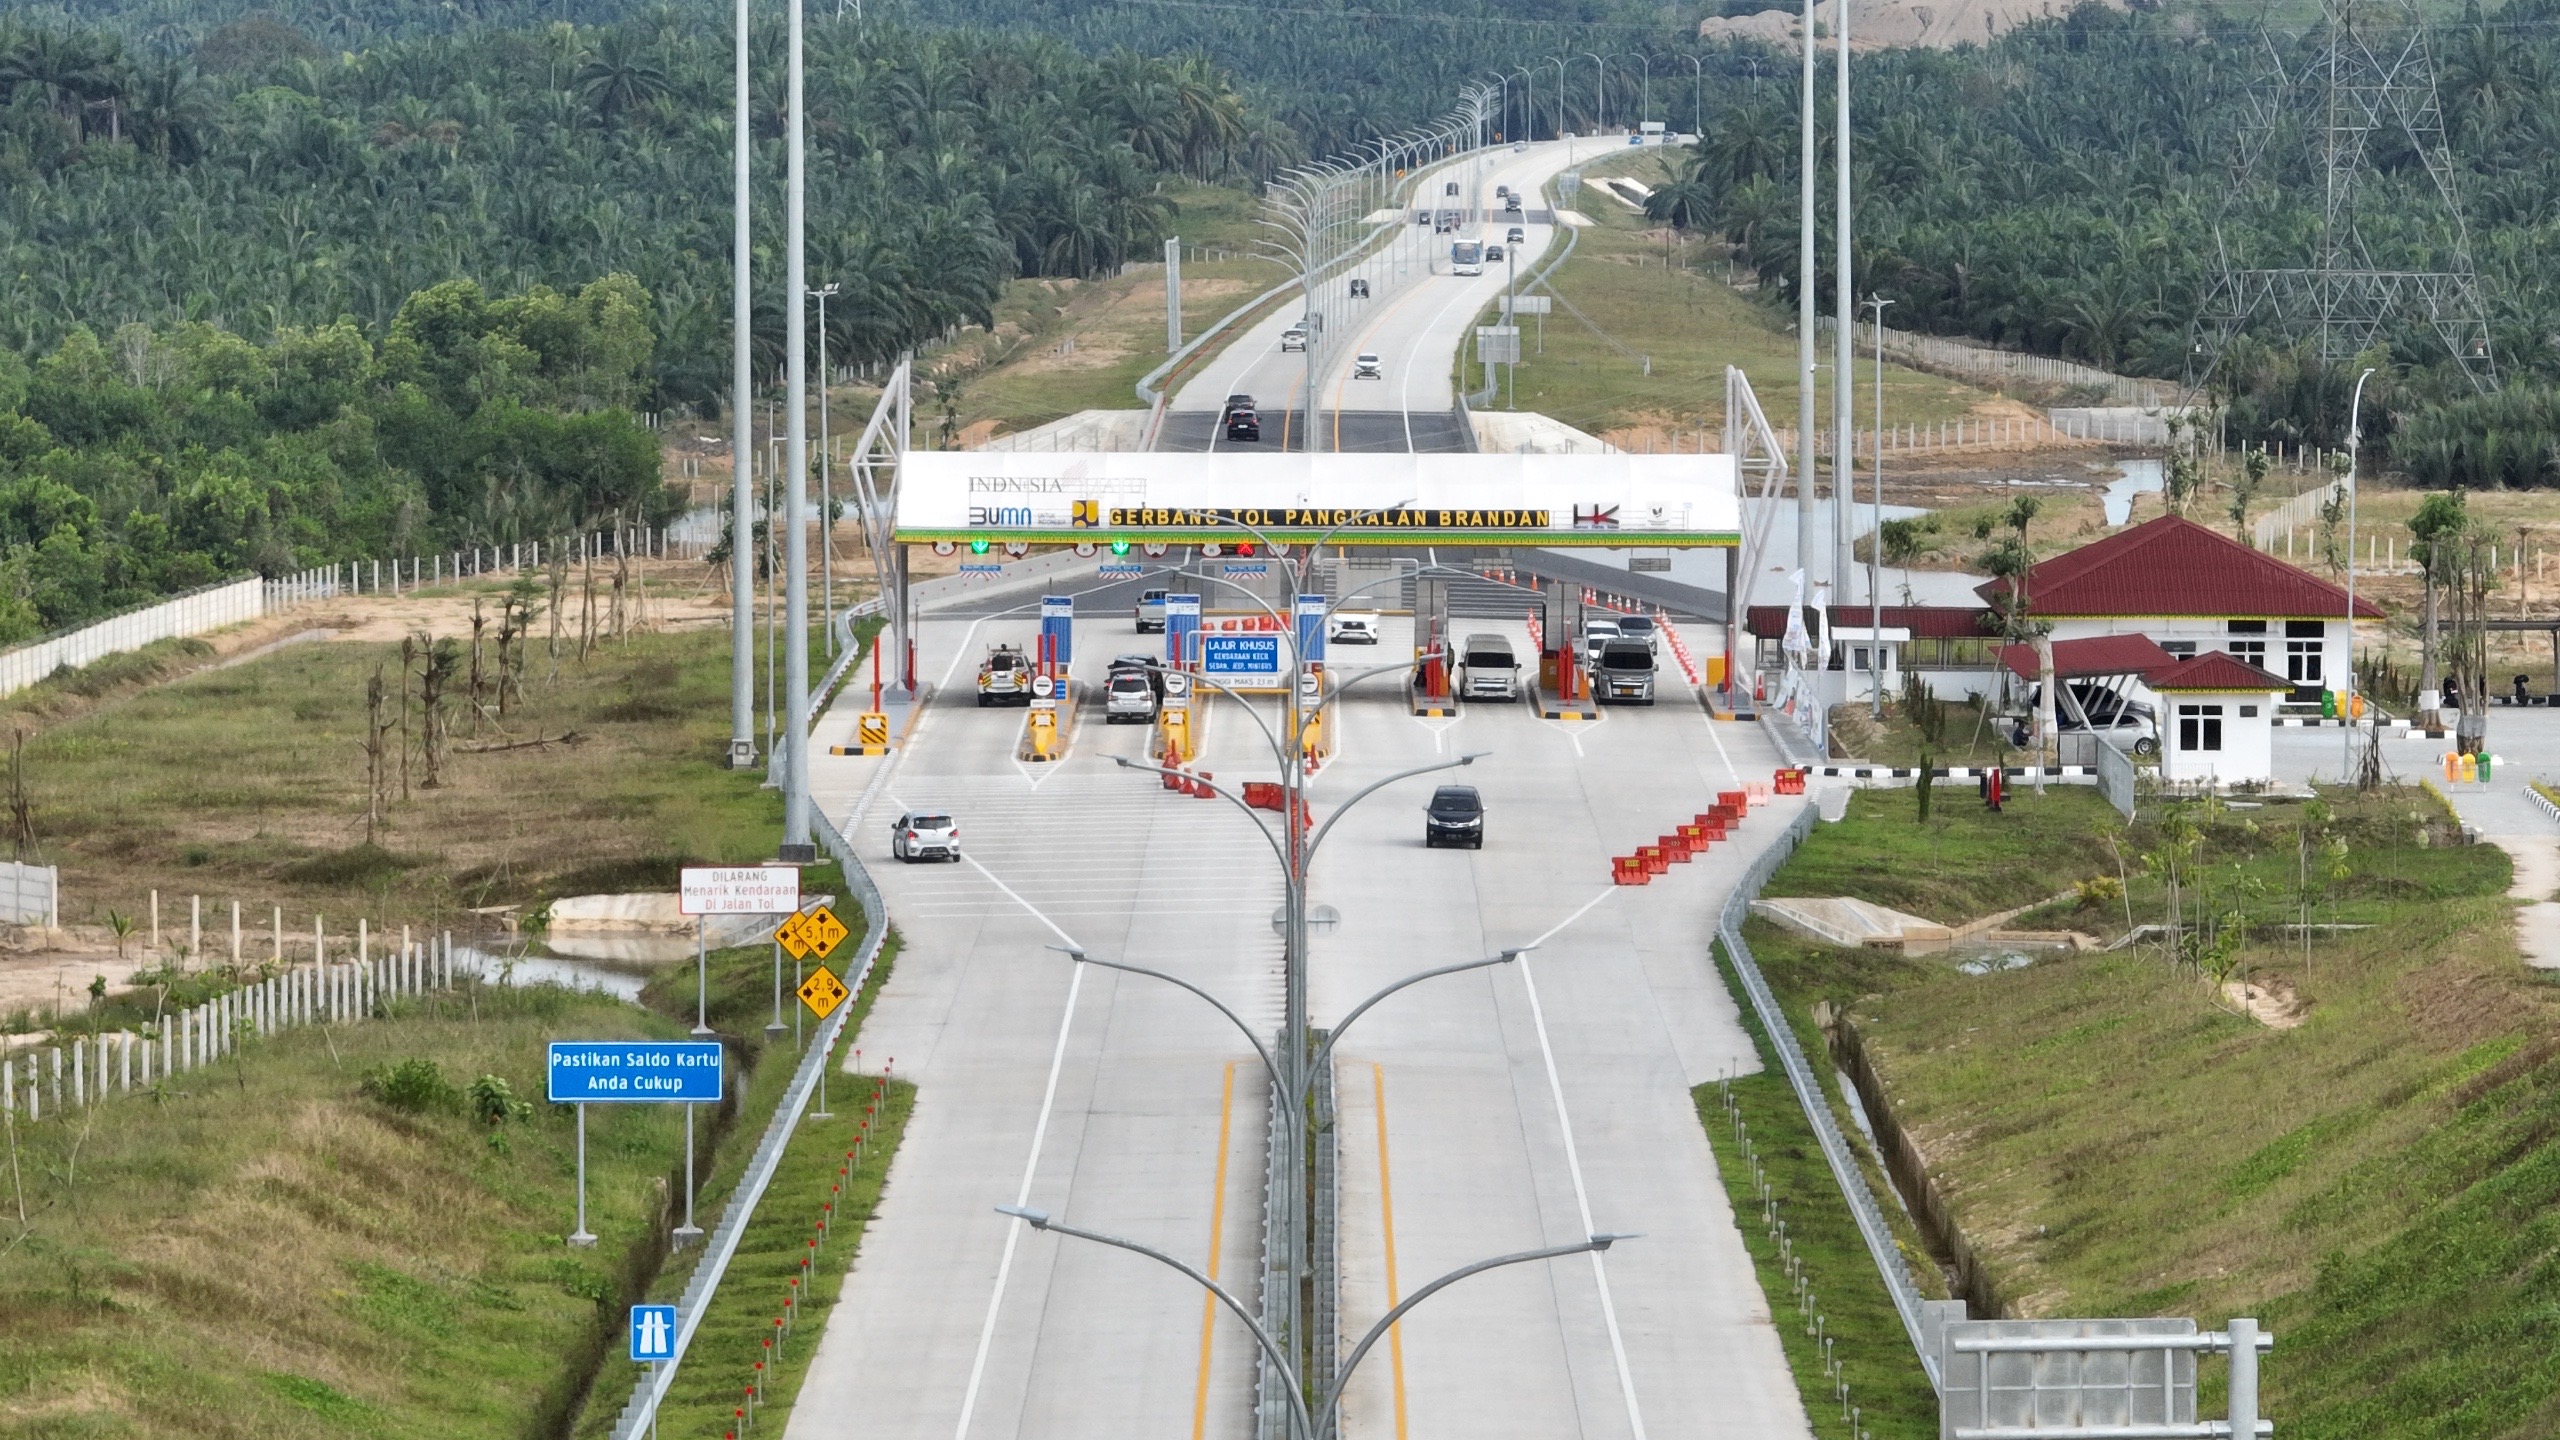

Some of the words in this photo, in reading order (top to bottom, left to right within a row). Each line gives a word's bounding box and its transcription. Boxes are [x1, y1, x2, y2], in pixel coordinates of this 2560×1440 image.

[1110, 508, 1219, 526] GERBANG
[1230, 508, 1274, 526] TOL
[1285, 508, 1427, 527] PANGKALAN
[1439, 509, 1549, 527] BRANDAN
[1209, 641, 1236, 650] LAJUR
[1239, 641, 1275, 650] KHUSUS
[712, 871, 768, 882] DILARANG
[684, 884, 729, 897] Menarik
[735, 884, 796, 896] Kendaraan
[721, 898, 752, 910] Jalan
[758, 898, 775, 910] Tol
[806, 926, 824, 940] 5,1
[827, 927, 840, 939] m
[813, 978, 834, 992] 2,9
[817, 997, 829, 1008] m
[552, 1052, 621, 1067] Pastikan
[626, 1052, 671, 1067] Saldo
[676, 1052, 719, 1067] Kartu
[588, 1075, 629, 1090] Anda
[634, 1075, 684, 1094] Cukup
